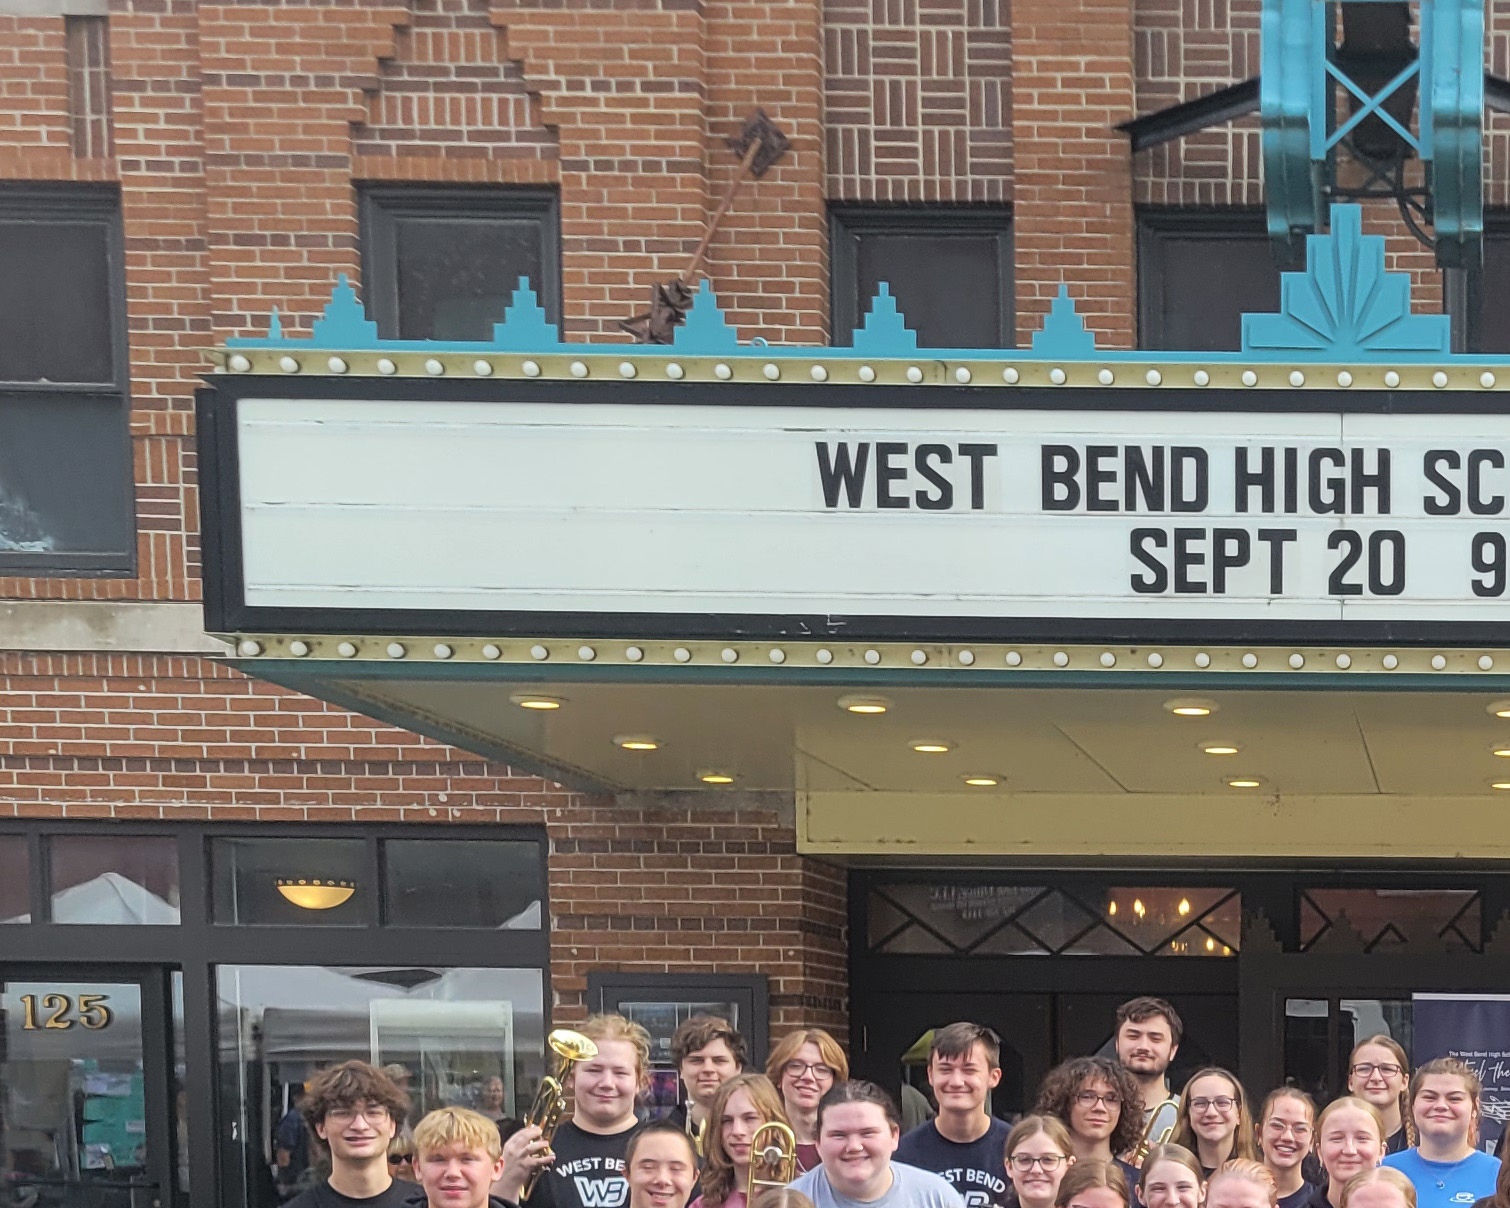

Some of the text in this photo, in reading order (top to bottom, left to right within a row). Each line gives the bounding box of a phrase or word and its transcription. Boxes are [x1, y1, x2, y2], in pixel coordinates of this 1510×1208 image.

[816, 442, 998, 511] WEST
[1042, 445, 1209, 512] BEND
[1236, 447, 1391, 514] HIGH
[1131, 528, 1297, 595] SEPT
[1328, 530, 1406, 596] 20
[20, 993, 110, 1029] 125
[556, 1157, 602, 1178] WEST
[966, 1169, 1006, 1193] BEND
